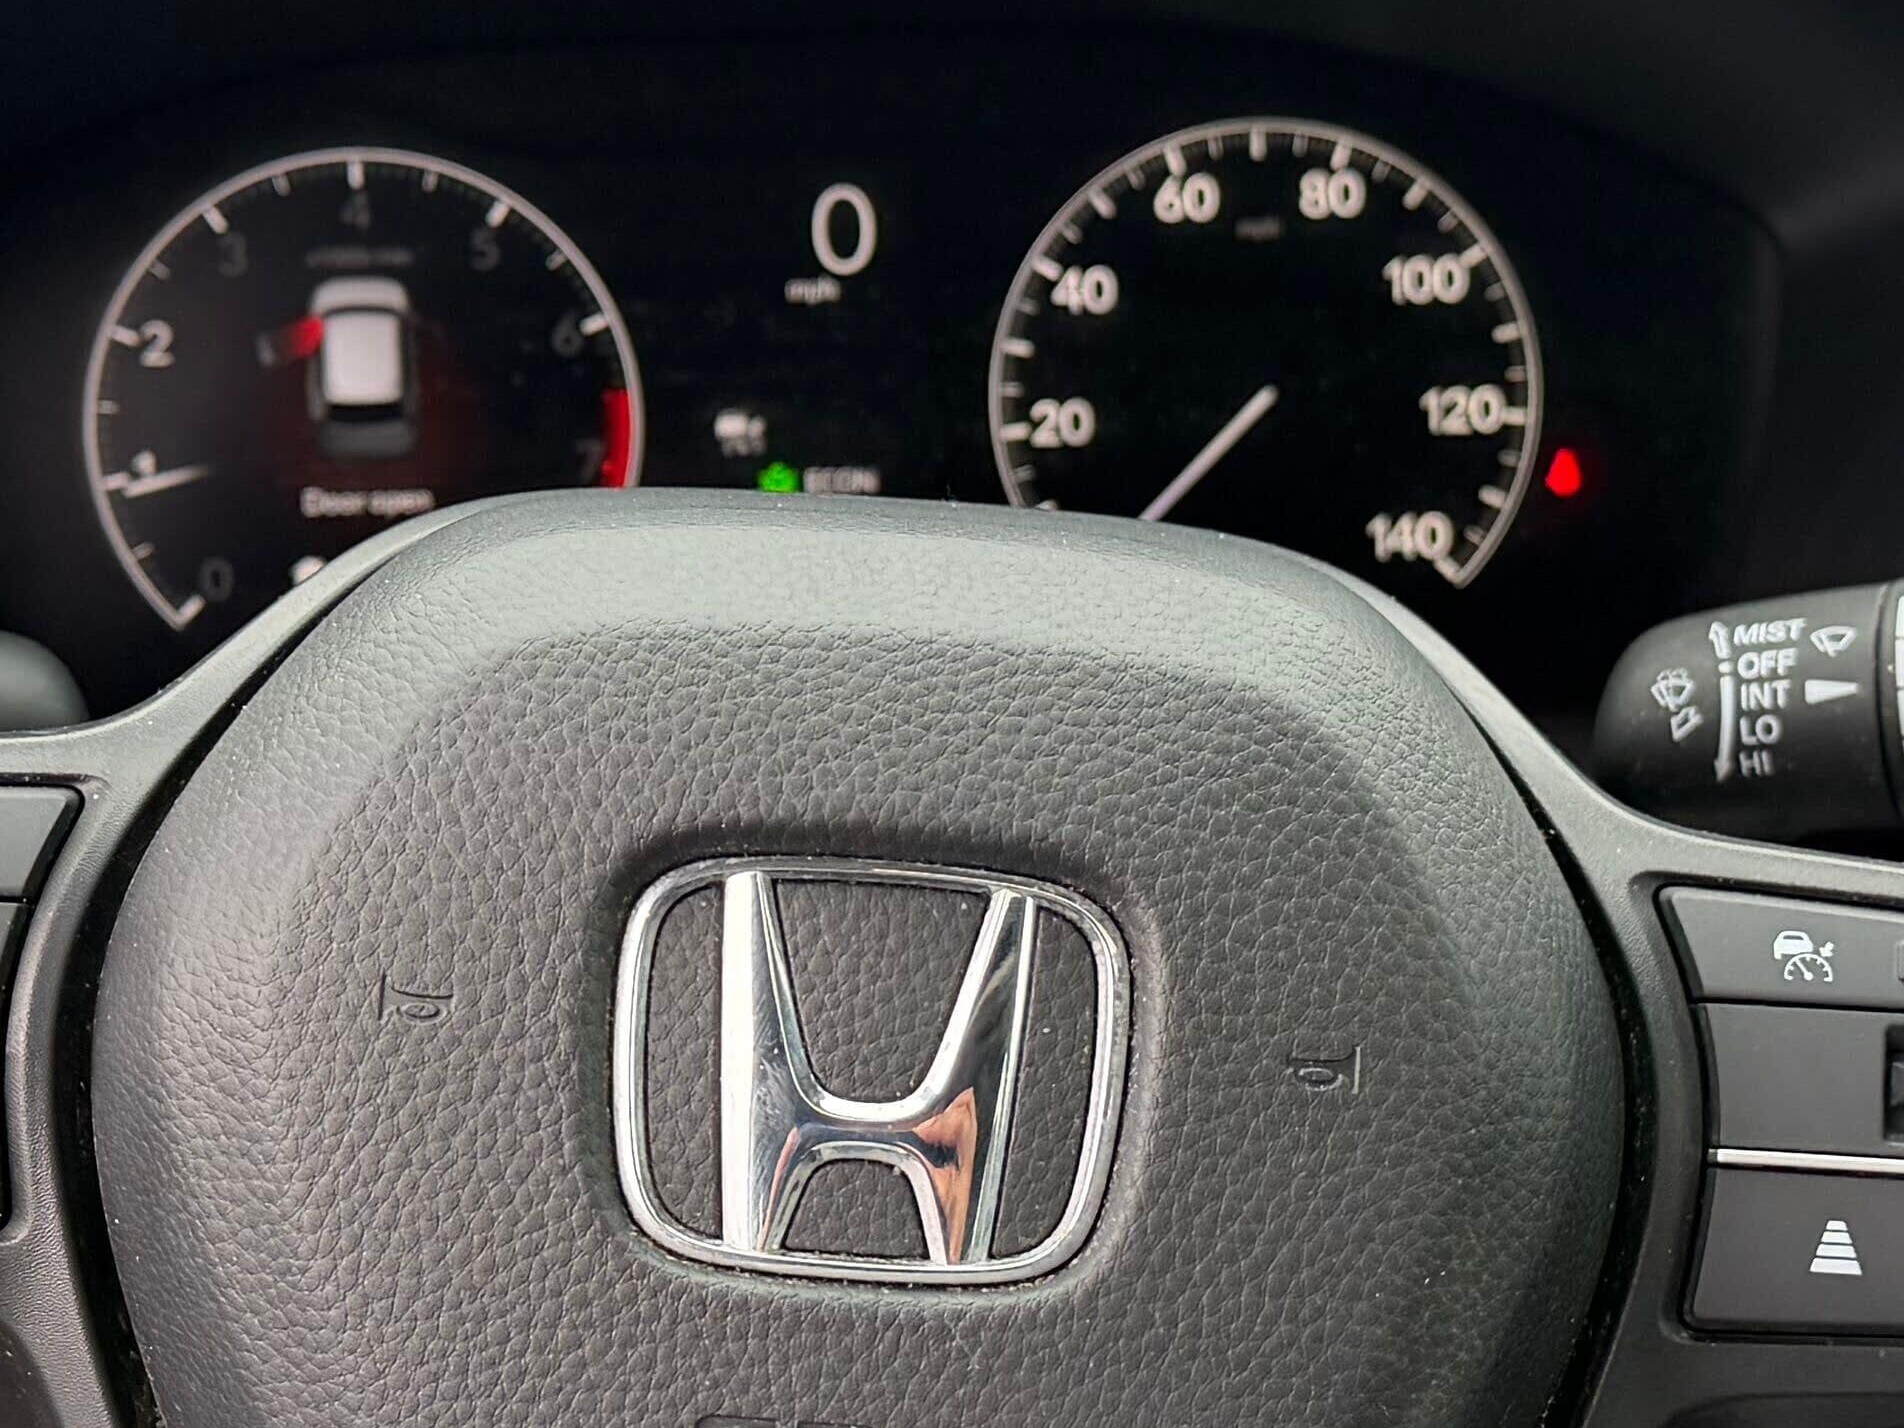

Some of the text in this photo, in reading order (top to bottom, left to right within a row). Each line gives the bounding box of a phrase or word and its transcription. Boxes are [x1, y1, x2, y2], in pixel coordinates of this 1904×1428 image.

[1153, 171, 1220, 224] 60
[1299, 168, 1367, 220] 80
[811, 182, 877, 276] 0
[1051, 263, 1120, 315] 40
[1383, 256, 1471, 306] 100
[138, 319, 175, 368] 2
[1030, 398, 1097, 449] 20
[1420, 384, 1503, 436] 120
[1367, 511, 1455, 564] 140
[1733, 617, 1807, 647] MIST
[1737, 647, 1799, 680] OFF
[1740, 678, 1792, 711] INT
[1739, 714, 1782, 746] LO
[1739, 749, 1774, 777] HI
